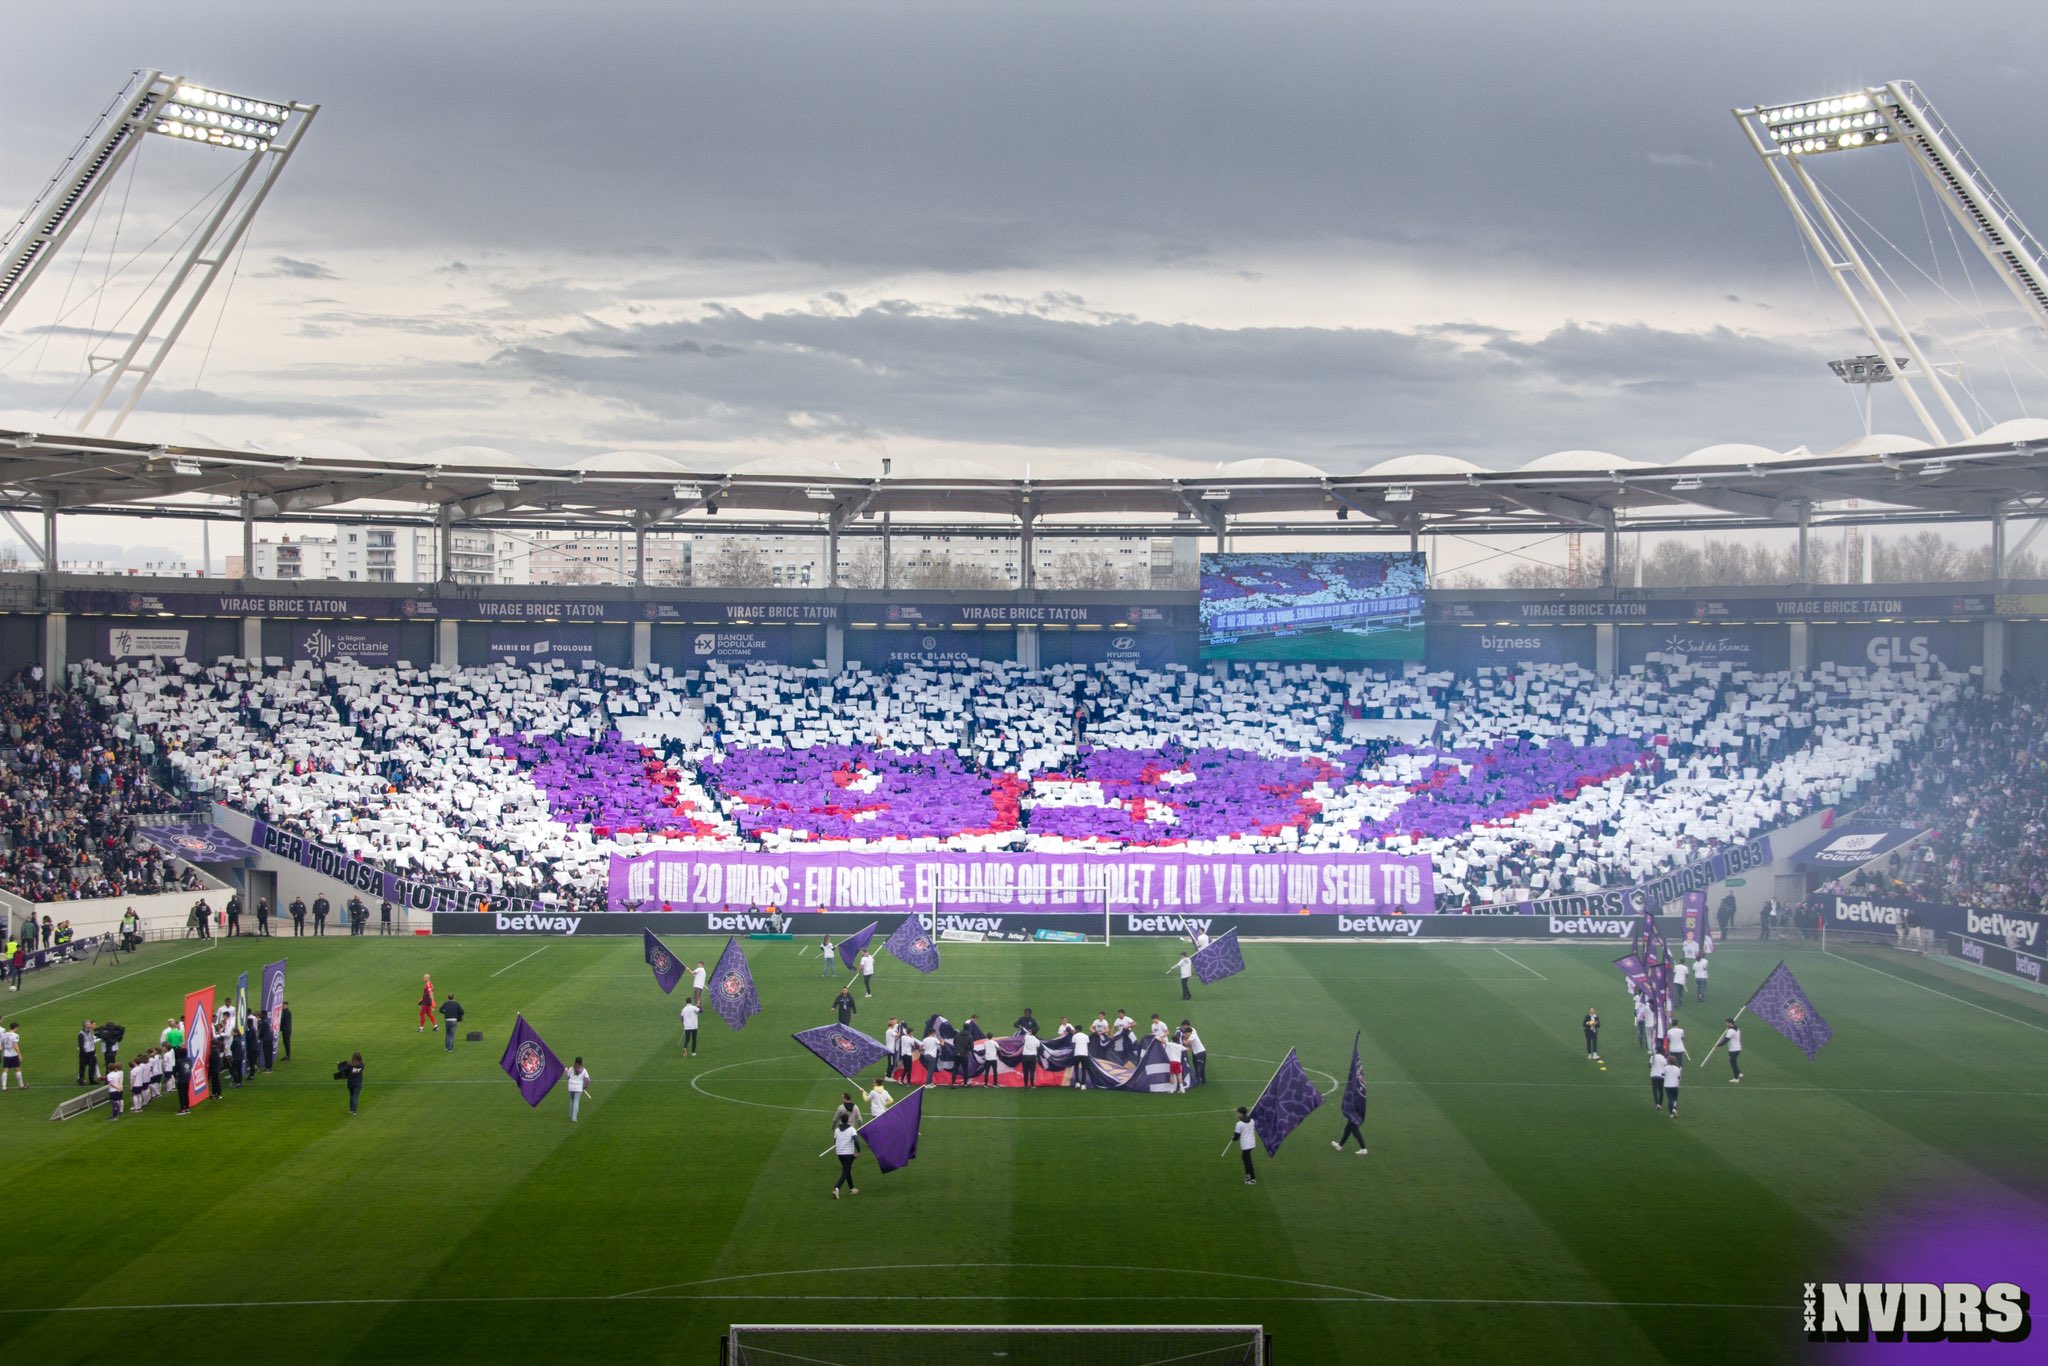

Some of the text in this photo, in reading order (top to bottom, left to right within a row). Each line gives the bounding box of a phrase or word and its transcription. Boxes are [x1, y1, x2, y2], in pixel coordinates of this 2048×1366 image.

[220, 598, 347, 613] VIRAGE BRICE TATON
[478, 603, 604, 616] VIRAGE BRICE TATON
[726, 606, 837, 618] VIRAGE BRICE TATON
[962, 607, 1088, 620] VIRAGE BRICE TATON
[1521, 603, 1647, 616] VIRAGE BRICE TATON
[1776, 600, 1902, 614] VIRAGE BRICE TATON
[717, 633, 754, 641] BANQUE
[1210, 636, 1238, 645] betway
[1481, 635, 1541, 649] bizness
[1685, 637, 1751, 653] Sud de France
[337, 641, 389, 651] Occitanie
[890, 652, 968, 660] SERGE BLANCO
[263, 824, 305, 864] PER
[307, 843, 384, 897] TOLOSA
[1649, 860, 1717, 907] TOLOSA
[1722, 841, 1764, 878] 1993
[693, 863, 723, 904] 20
[805, 866, 832, 907] EN
[943, 863, 1015, 905] BLANC
[1017, 863, 1047, 905] OU
[1050, 863, 1078, 905] EN
[1163, 864, 1181, 905] IL
[1228, 864, 1245, 904] A
[1322, 864, 1376, 905] SEUL
[1380, 864, 1422, 905] TFC
[496, 913, 581, 934] betway
[707, 913, 792, 932] betwy
[1127, 914, 1213, 934] betway
[1338, 915, 1423, 937] betway
[1550, 916, 1635, 938] betway
[1967, 909, 2039, 946] betway
[1962, 938, 1984, 965] betway
[2015, 952, 2041, 982] betway
